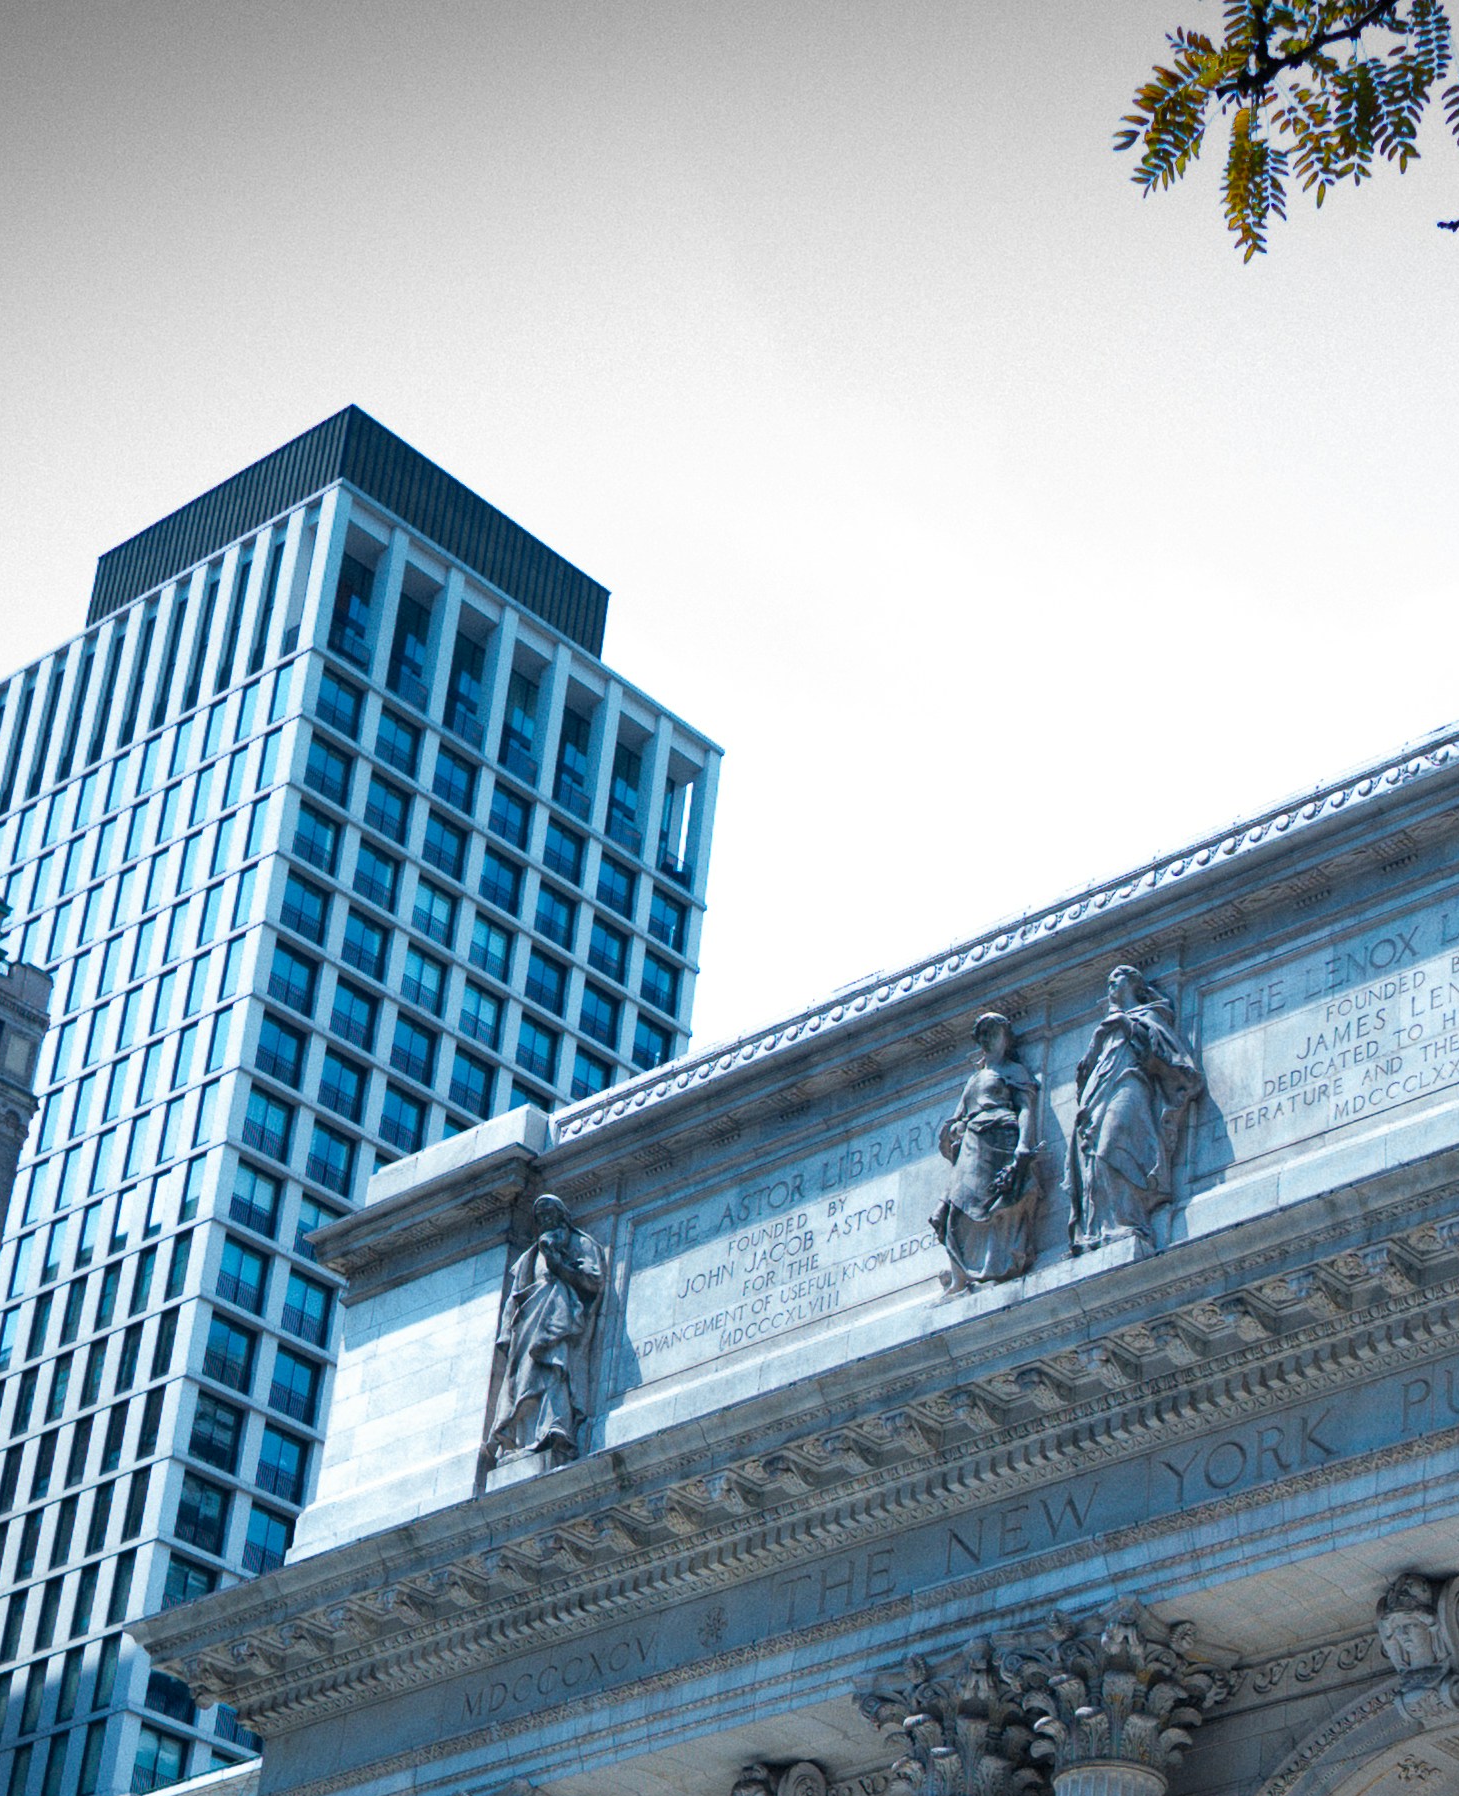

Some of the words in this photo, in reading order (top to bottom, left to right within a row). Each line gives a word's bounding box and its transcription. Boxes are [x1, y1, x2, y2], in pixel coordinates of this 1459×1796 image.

[1223, 980, 1287, 1030] THE
[1304, 926, 1419, 999] LENOX
[1325, 970, 1425, 1022] FOUNDED
[1263, 1040, 1379, 1098] DEDICATED
[1392, 1022, 1423, 1049] TO
[1296, 1007, 1386, 1060] JAMES
[1361, 1055, 1403, 1086] AND
[1419, 1033, 1459, 1062] THE
[651, 1214, 699, 1257] THE
[716, 1173, 805, 1231] ASTOR
[820, 1120, 940, 1191] LIBRARY
[677, 1261, 734, 1299] JOHN
[744, 1230, 814, 1273] JACOB
[827, 1199, 895, 1242] ASTOR
[727, 1213, 807, 1256] FOUNDED
[826, 1196, 847, 1218] BY
[742, 1269, 776, 1297] FOR
[786, 1253, 819, 1279] THE
[632, 1303, 747, 1362] ADVANCEMENT
[750, 1294, 772, 1316] OF
[779, 1272, 836, 1304] USEFUL
[719, 1290, 840, 1351] MDCCCXLVIII
[460, 1630, 658, 1722] MDCCCXCV
[780, 1547, 897, 1624] THE
[944, 1481, 1100, 1575] NEW
[1160, 1407, 1340, 1503] YORK
